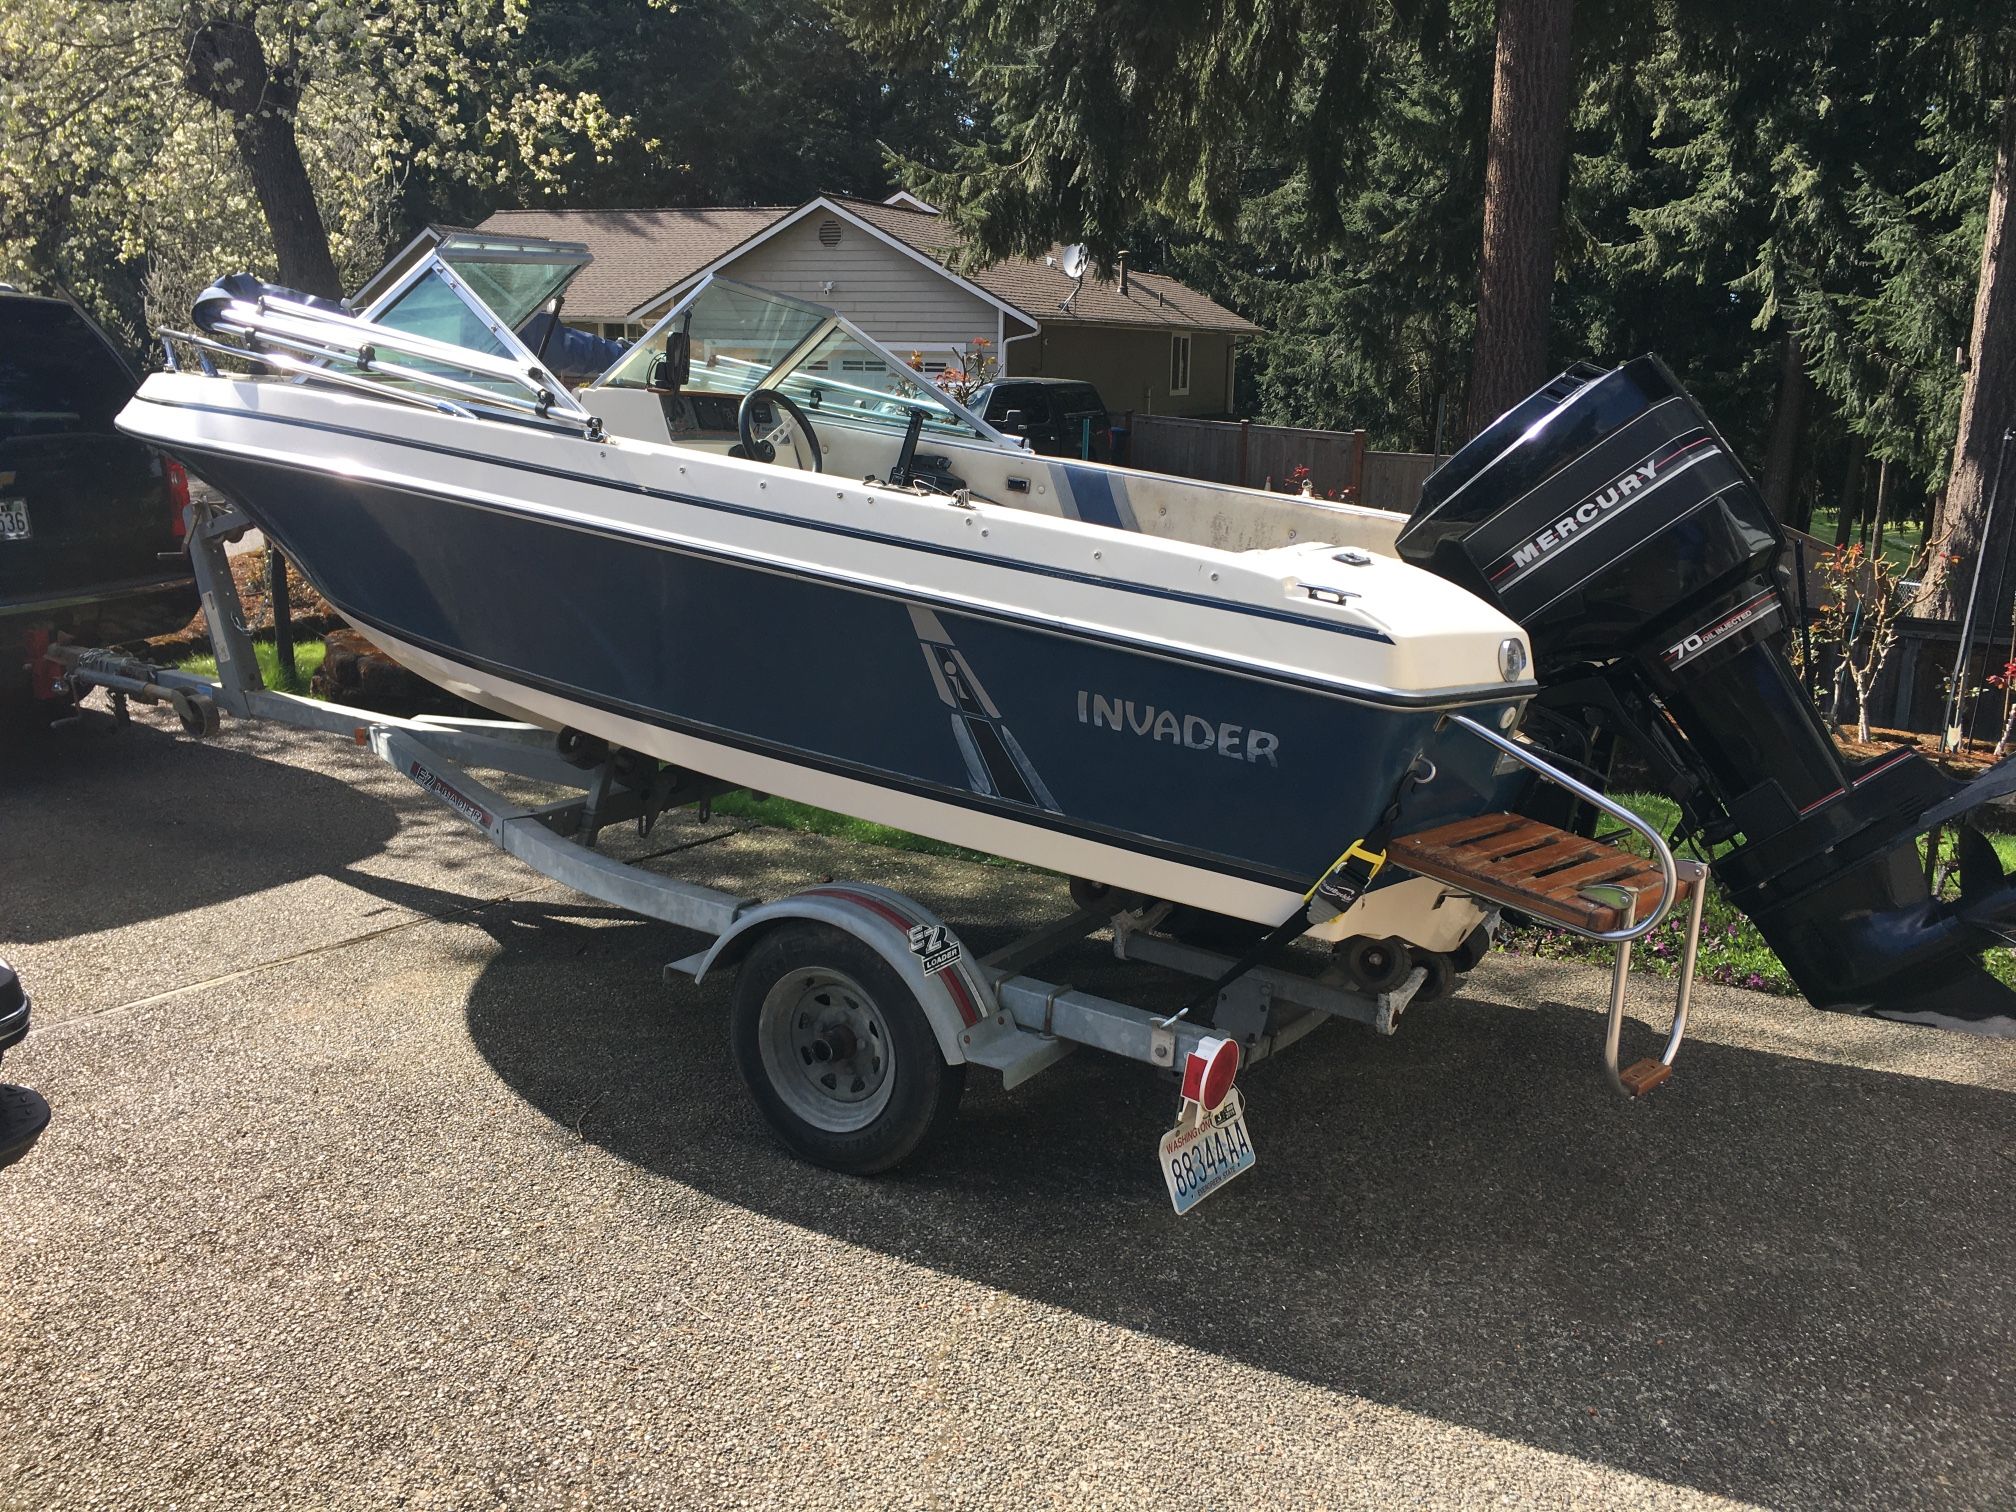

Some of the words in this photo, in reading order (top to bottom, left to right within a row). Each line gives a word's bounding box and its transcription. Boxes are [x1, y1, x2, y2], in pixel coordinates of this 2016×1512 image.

[1512, 460, 1657, 568] MERCURY
[1669, 634, 1703, 660] 70
[1702, 632, 1717, 643] OIL
[1715, 610, 1753, 635] INJECTED
[1078, 690, 1279, 768] INVADER
[909, 925, 942, 954] EZ
[926, 949, 958, 969] LOADER
[1171, 1119, 1250, 1197] 88344AA
